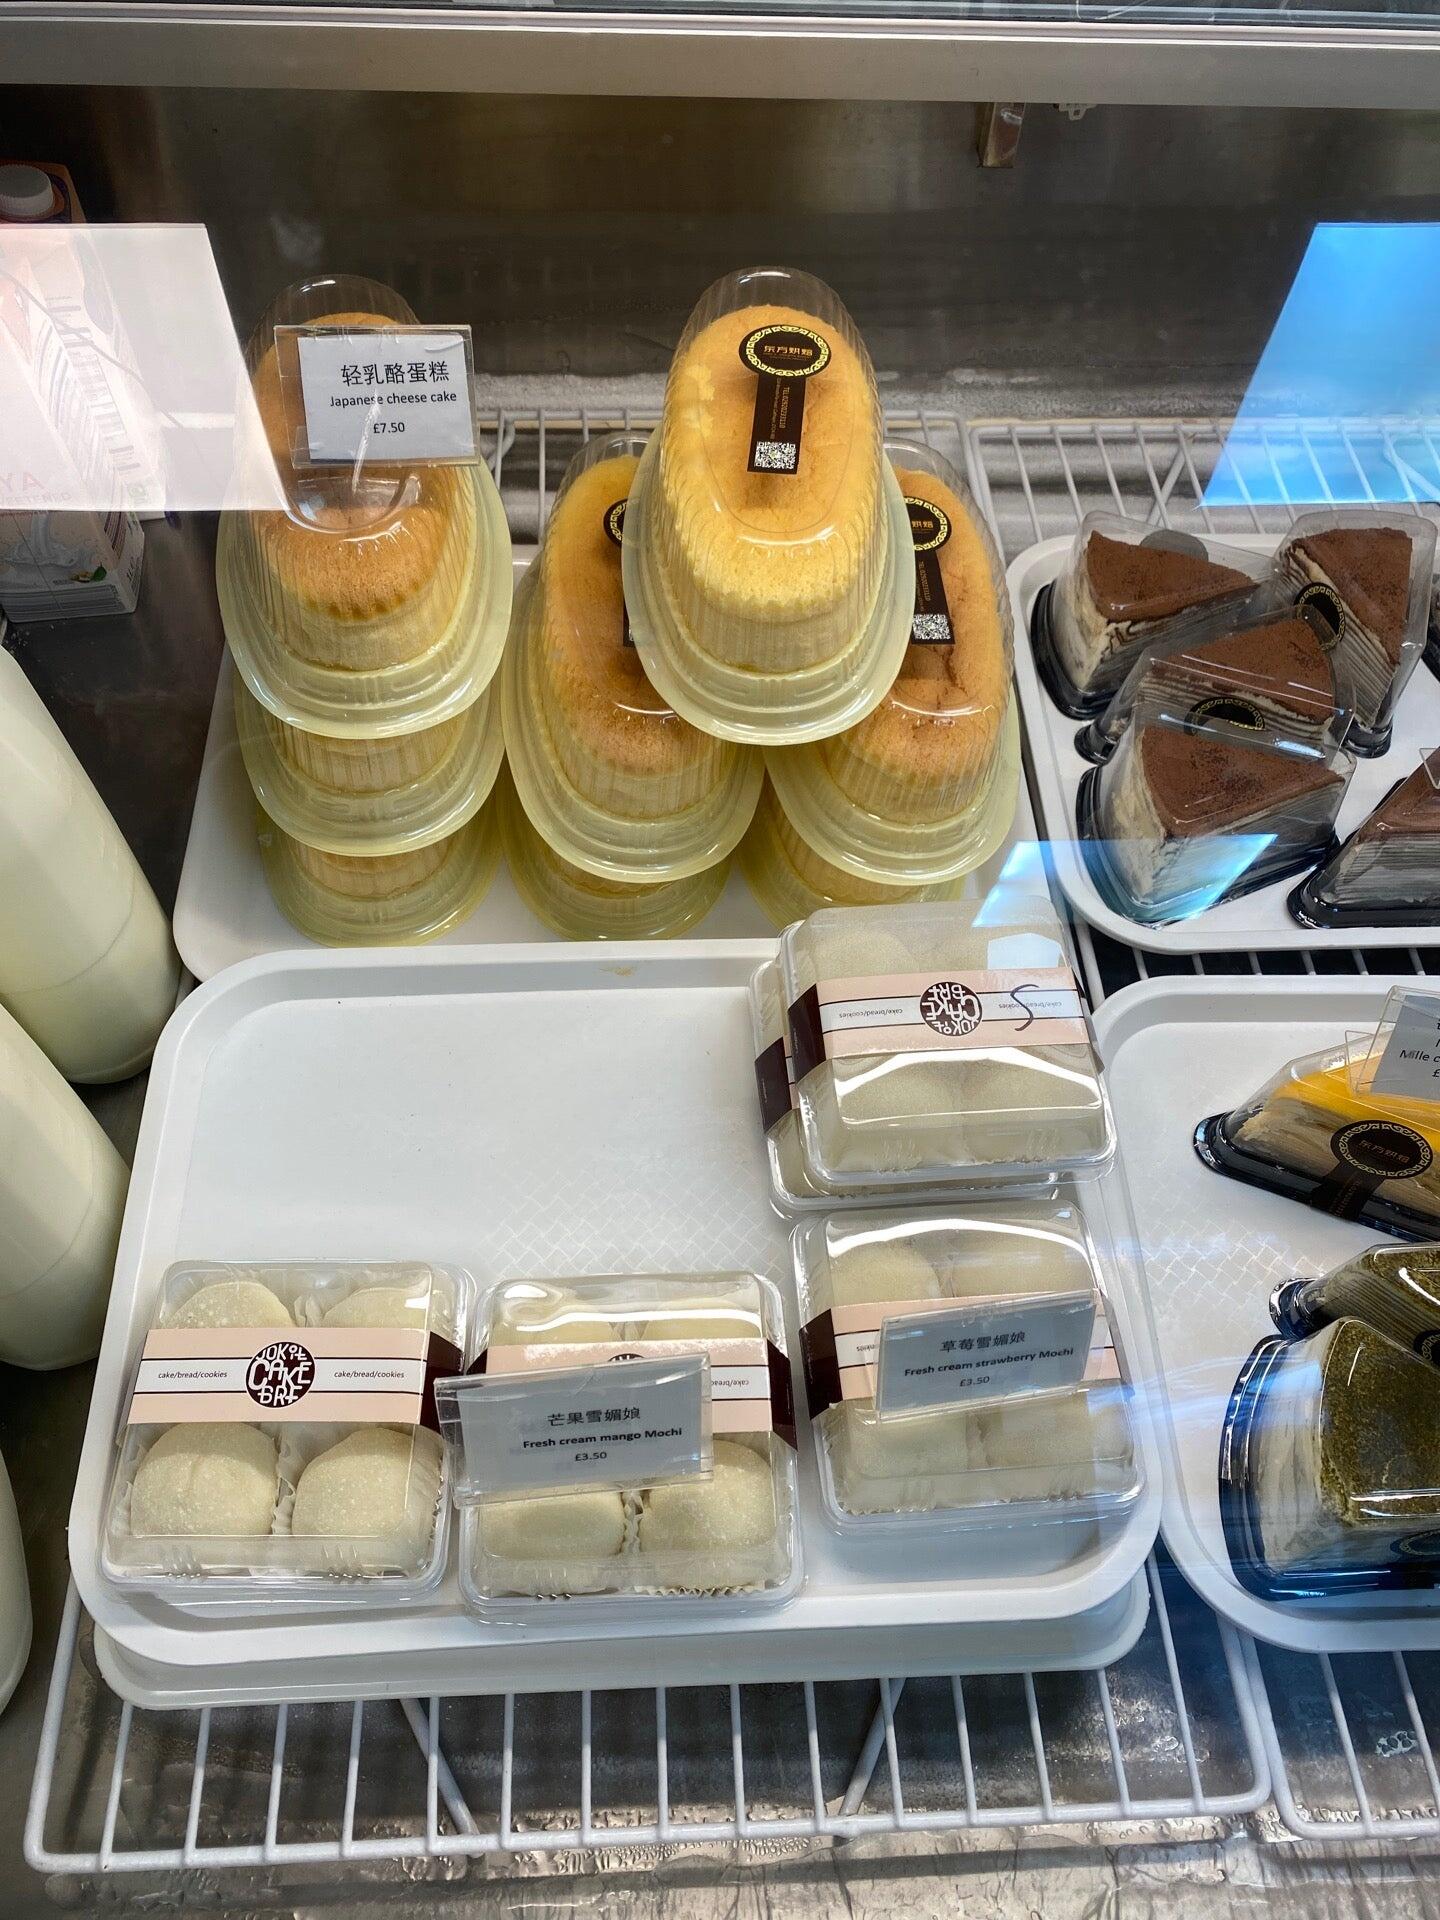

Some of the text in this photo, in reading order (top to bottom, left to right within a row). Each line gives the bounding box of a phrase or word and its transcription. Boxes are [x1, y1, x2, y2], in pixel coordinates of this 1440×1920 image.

[341, 360, 450, 387] 轻乳酪蛋糕
[330, 390, 457, 408] Japanese cheese cake
[373, 422, 405, 434] £7.50
[839, 1008, 903, 1019] cake/bread/cookies
[904, 1347, 1074, 1377] Fresh cream strawberry Mochi
[158, 1370, 228, 1380] cake/bread/cookies
[247, 1359, 313, 1390] CAKE
[333, 1370, 405, 1380] cake/bread/cookies
[959, 1375, 990, 1388] £3.50
[547, 1406, 641, 1427] 芒果雪媚娘
[523, 1427, 683, 1449] Fresh cream mango Mochi
[574, 1450, 608, 1462] £3.50
